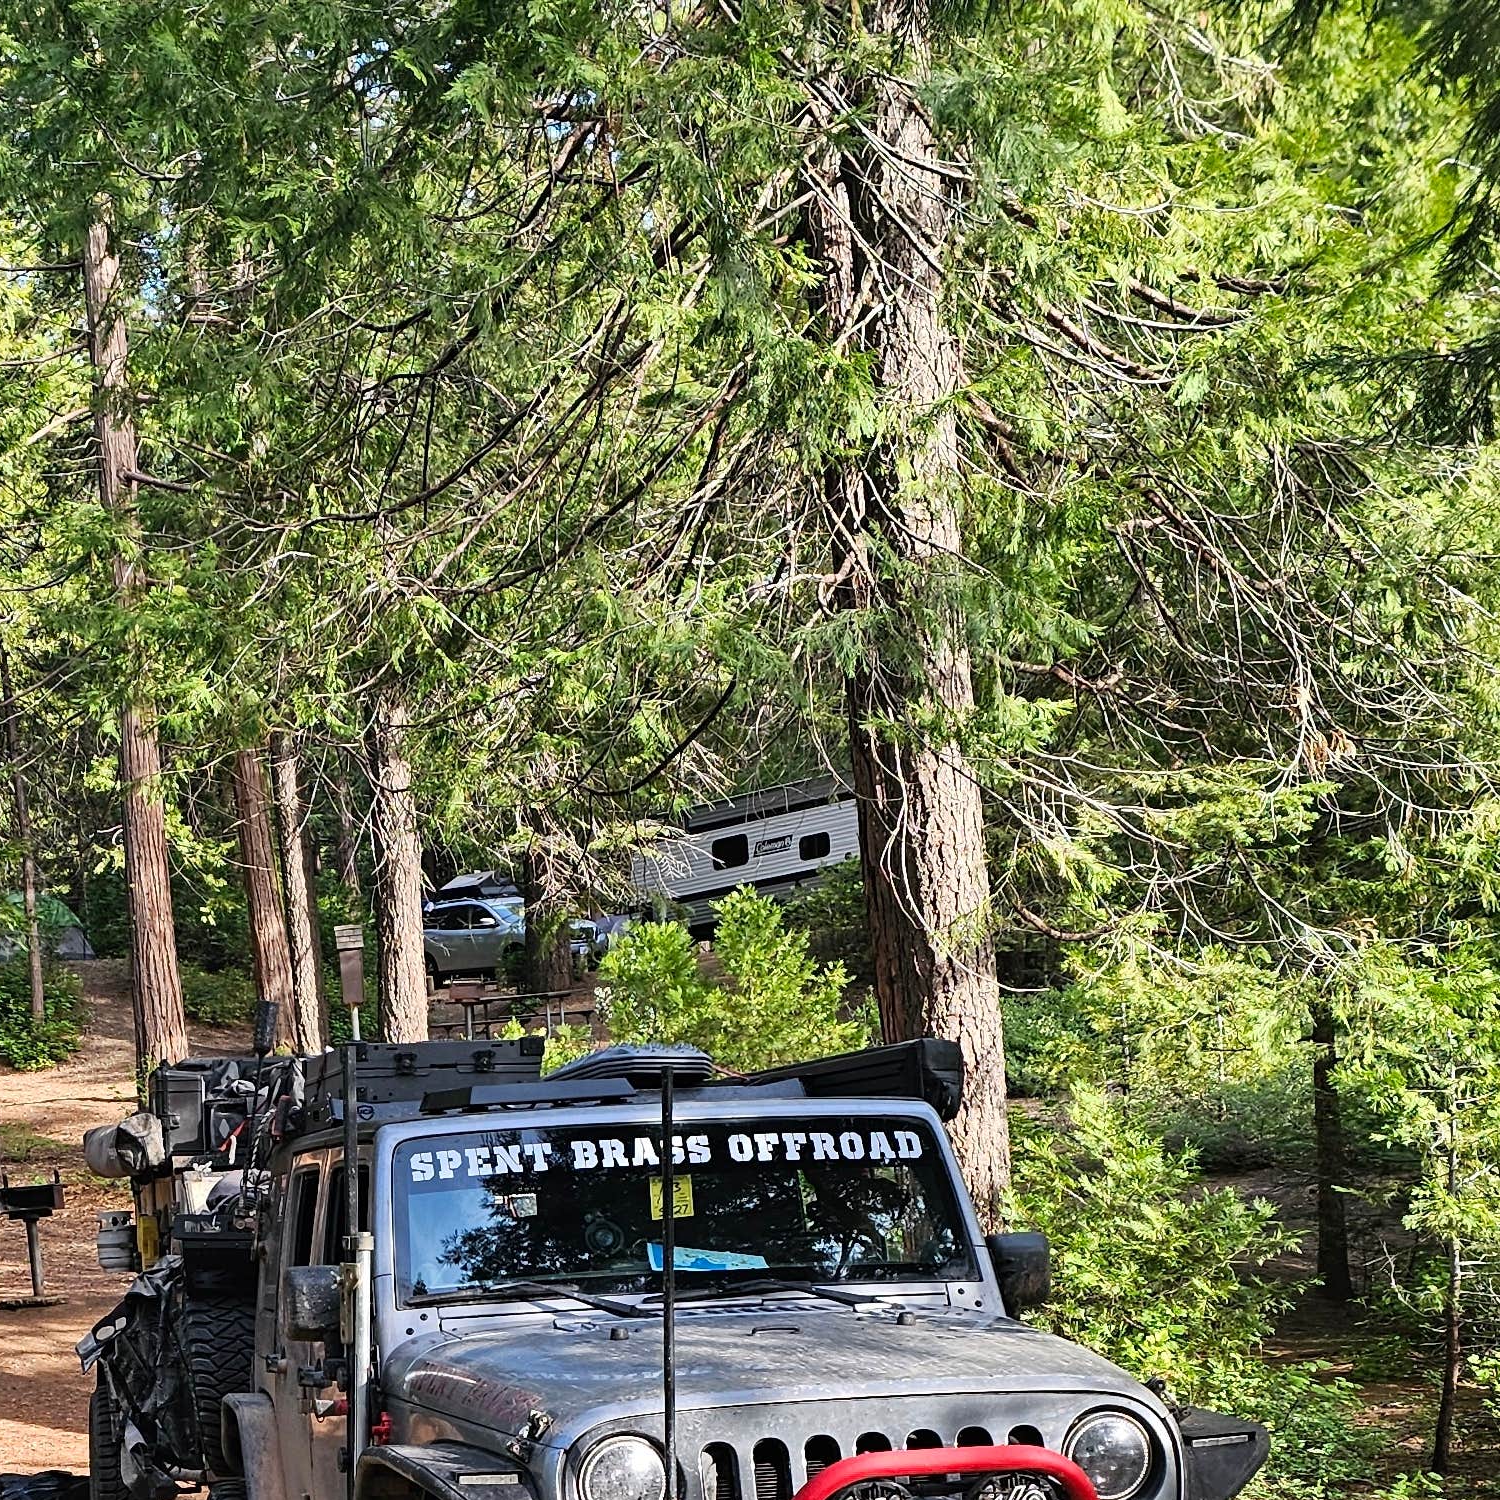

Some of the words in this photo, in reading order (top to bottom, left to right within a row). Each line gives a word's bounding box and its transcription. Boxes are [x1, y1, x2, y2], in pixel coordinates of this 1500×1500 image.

[757, 840, 785, 852] Coleman
[410, 1143, 551, 1182] SPENT
[728, 1131, 923, 1162] OFFROAD
